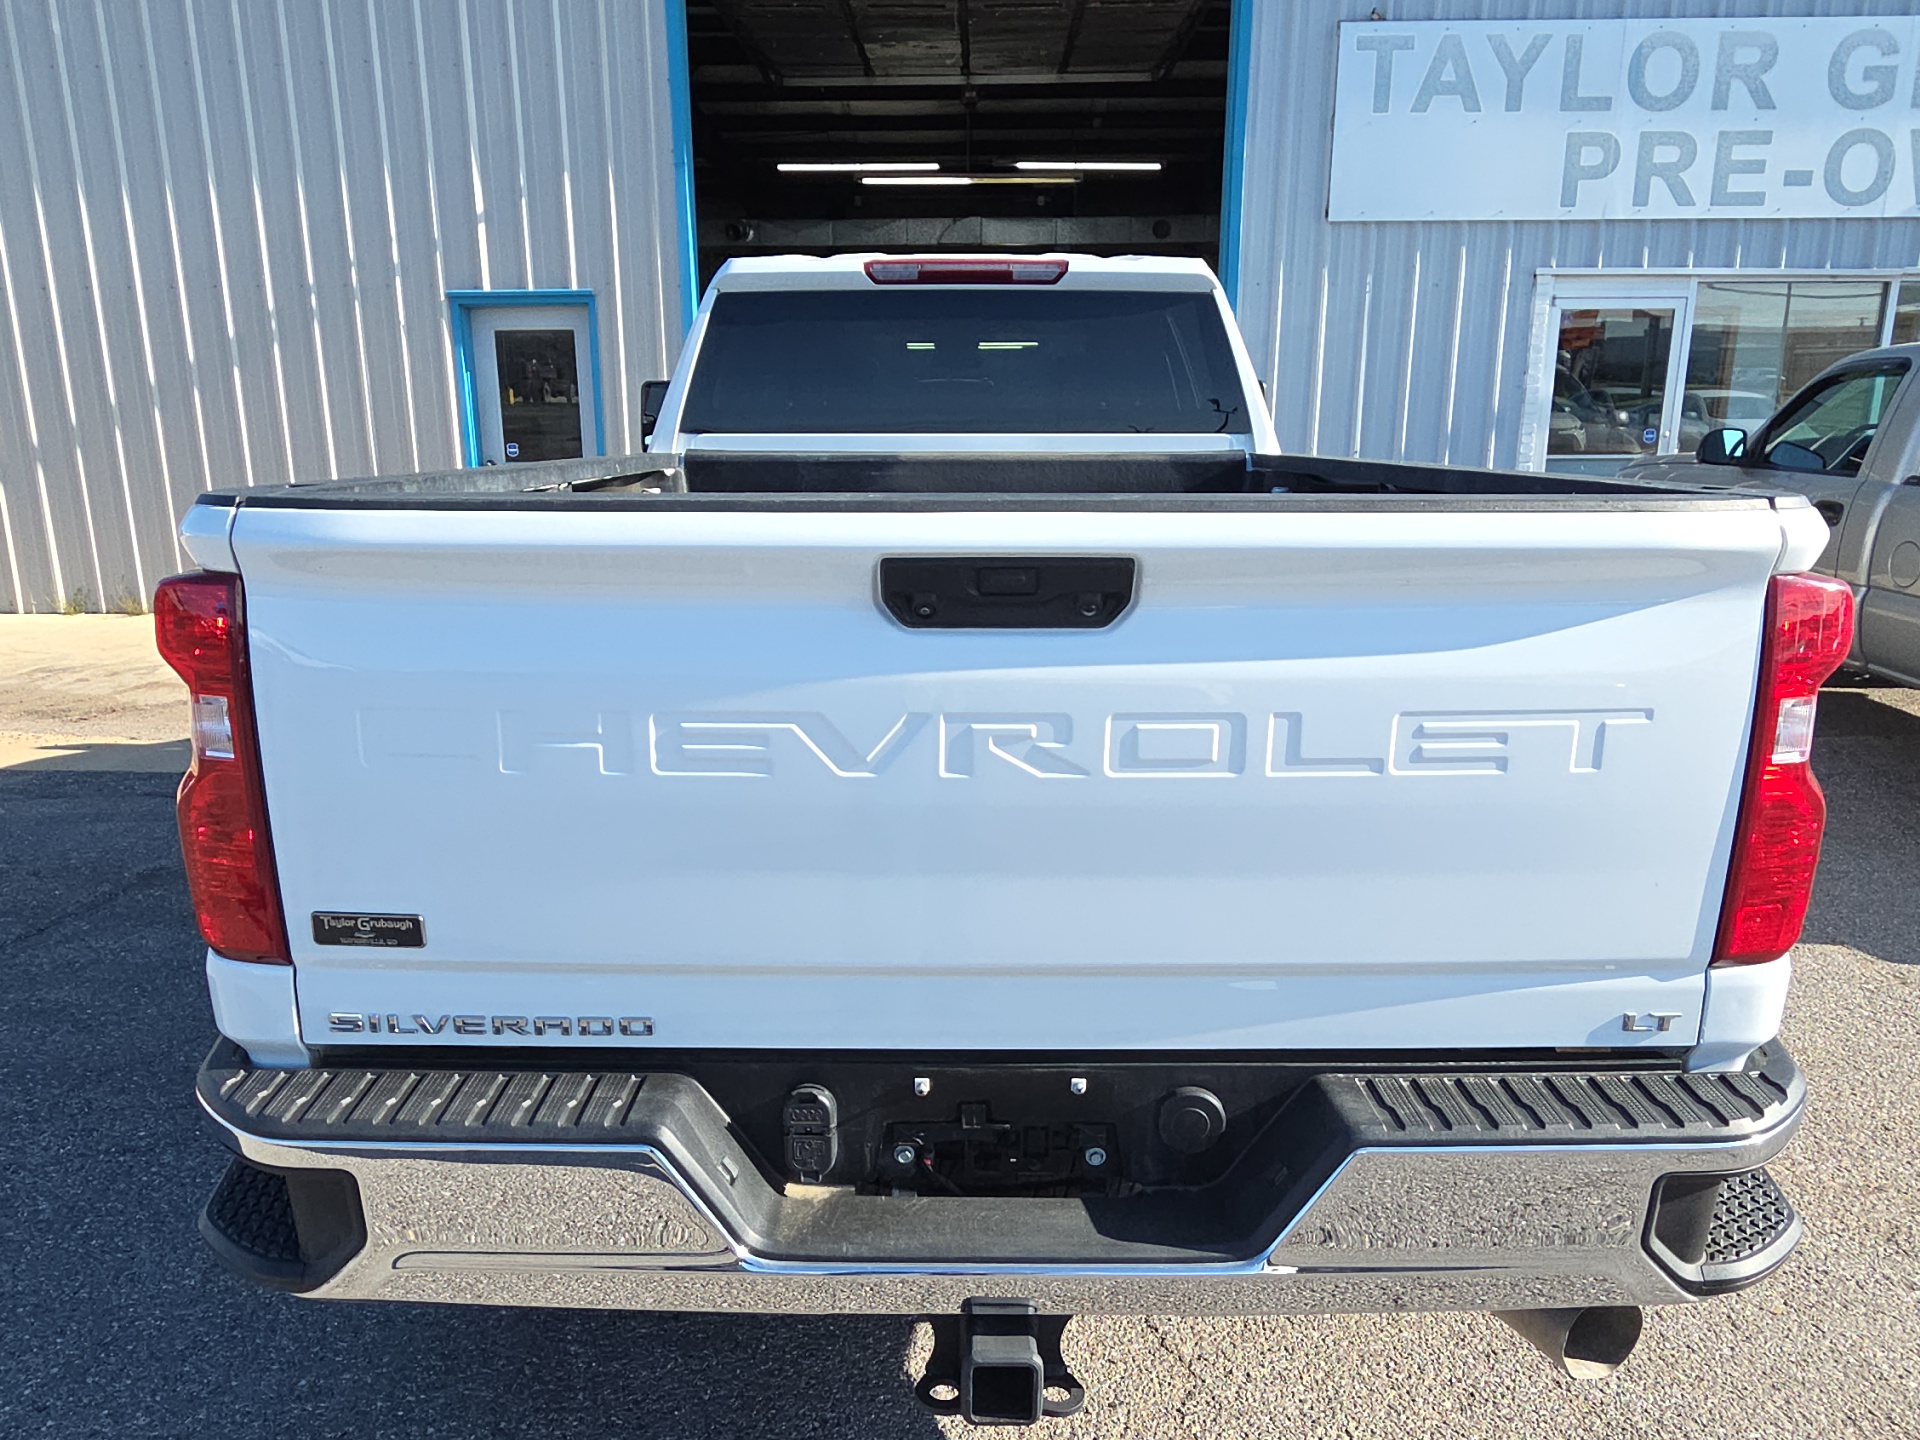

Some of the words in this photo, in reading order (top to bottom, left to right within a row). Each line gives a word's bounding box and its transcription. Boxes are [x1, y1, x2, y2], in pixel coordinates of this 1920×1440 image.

[1356, 31, 1779, 114] TAYLOR
[1827, 28, 1920, 112] G
[1559, 127, 1920, 208] PRE-O
[356, 708, 1655, 778] CHEVROLET
[319, 915, 356, 930] Taylor
[357, 917, 413, 931] Grubaugh
[328, 1012, 656, 1037] SILVERADO
[1622, 1011, 1683, 1032] LT
